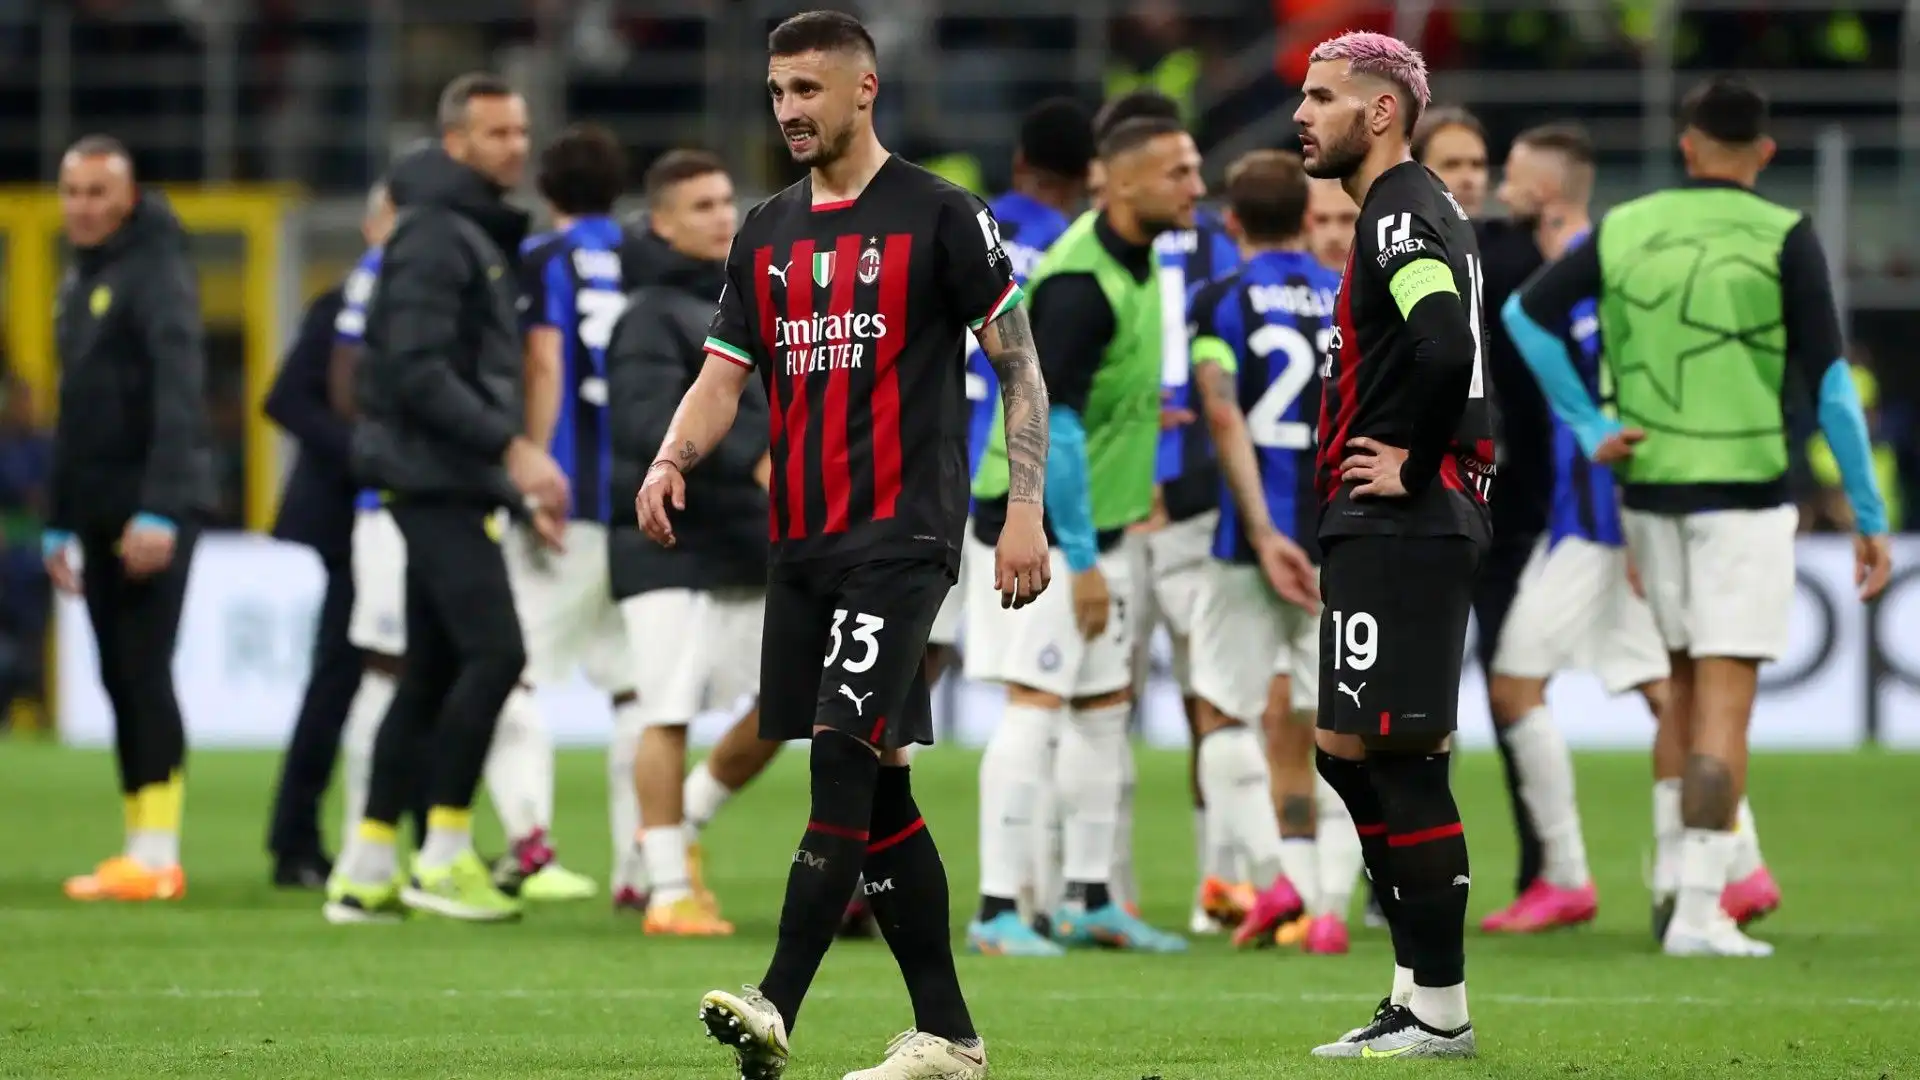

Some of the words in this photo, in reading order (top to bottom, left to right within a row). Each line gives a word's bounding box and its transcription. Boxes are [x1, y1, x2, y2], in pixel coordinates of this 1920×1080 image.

[987, 245, 1006, 268] Bit
[1376, 238, 1427, 268] BitMEX
[775, 309, 887, 347] Emirates
[786, 349, 808, 376] FLY
[808, 343, 864, 373] BETTER
[823, 608, 885, 674] 33
[1332, 610, 1379, 671] 19
